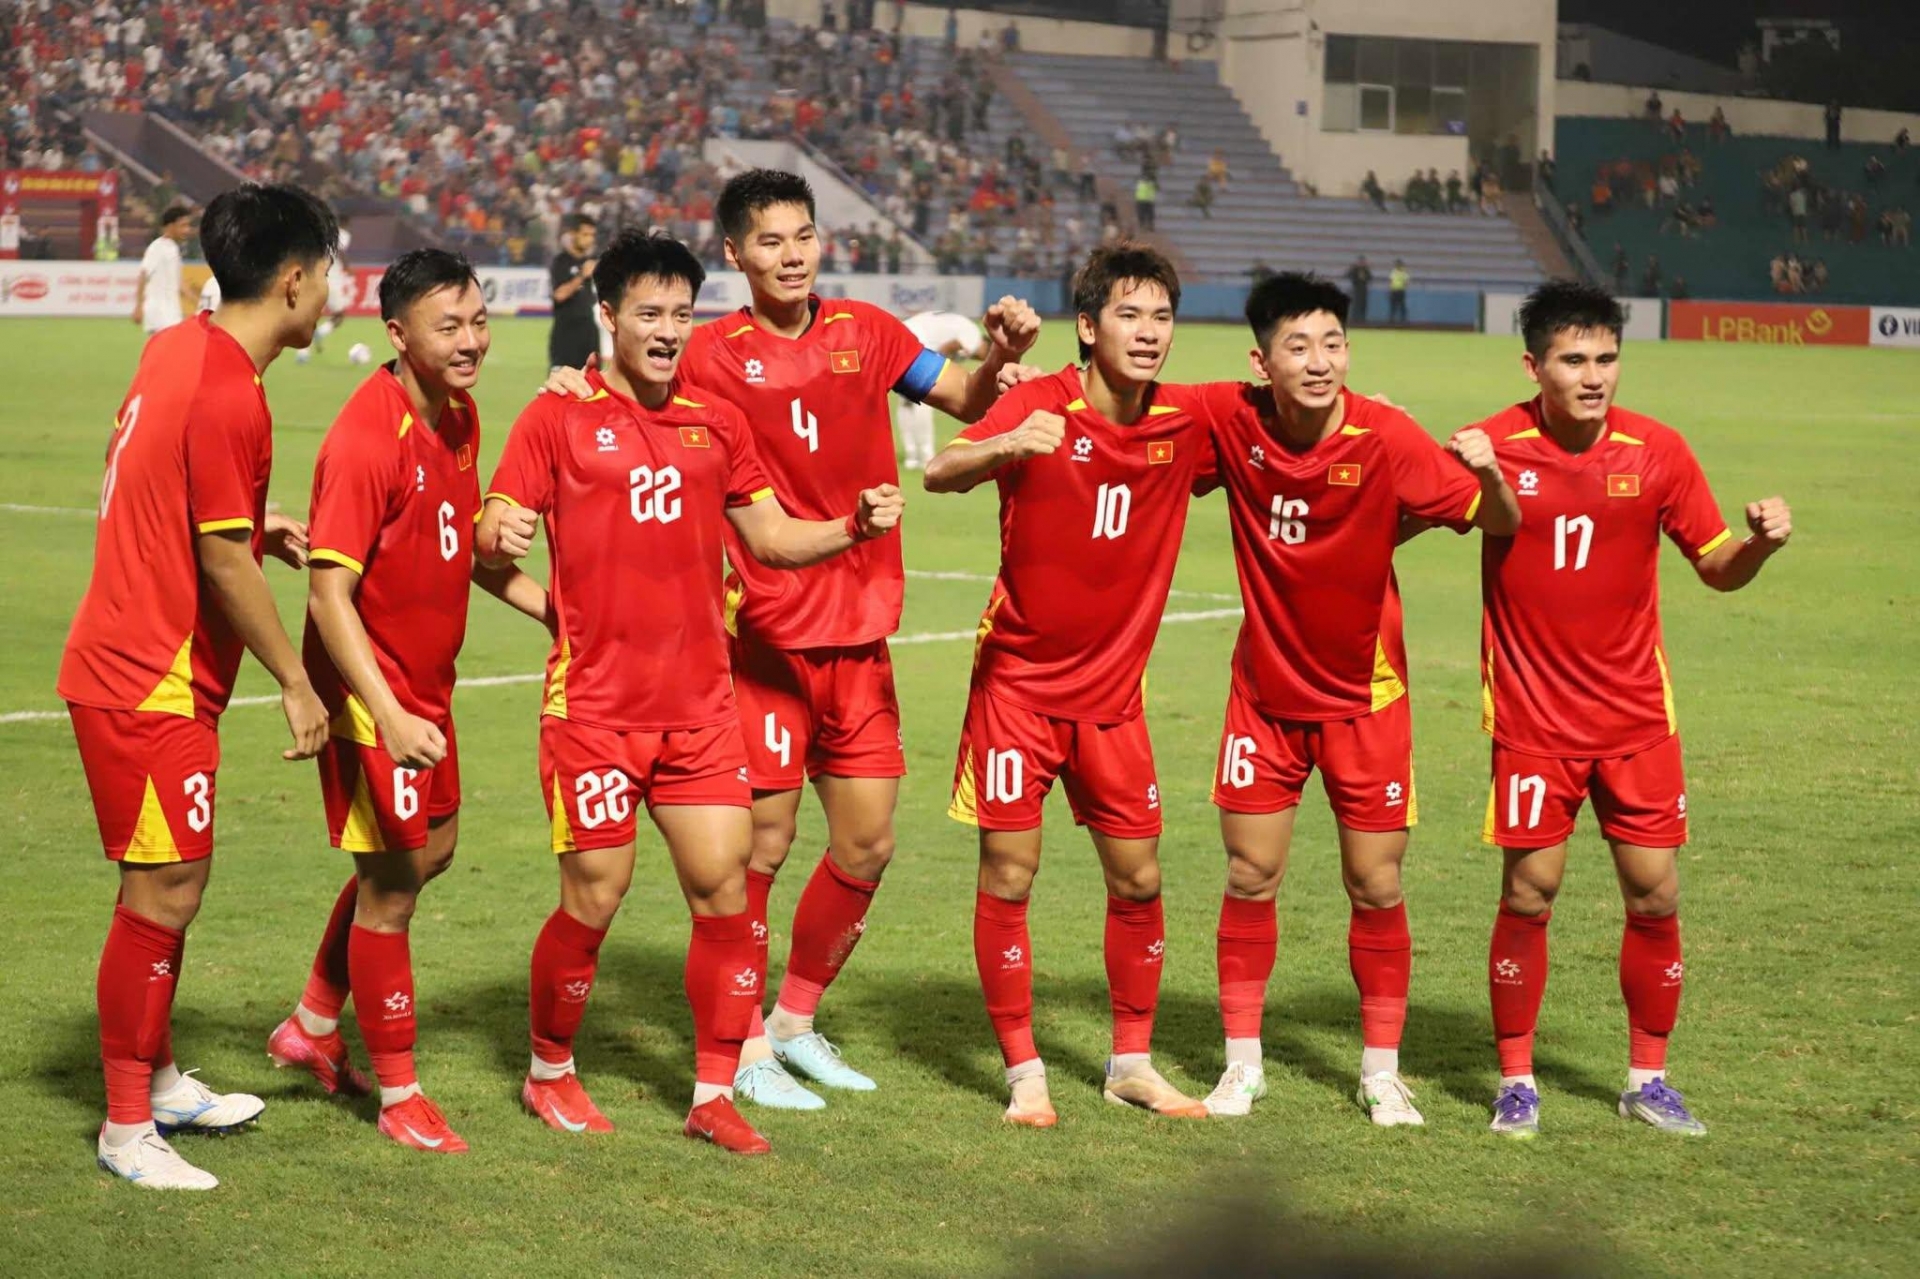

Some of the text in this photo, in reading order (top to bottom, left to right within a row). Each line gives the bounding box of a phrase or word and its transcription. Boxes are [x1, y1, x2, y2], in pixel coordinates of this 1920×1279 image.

[1702, 316, 1805, 346] LPBank
[791, 397, 819, 453] 4
[629, 465, 682, 524] 22
[1092, 483, 1132, 540] 10
[1268, 494, 1309, 545] 16
[438, 500, 459, 561] 6
[1554, 514, 1594, 571] 17
[764, 712, 791, 768] 4
[1222, 733, 1257, 789] 16
[183, 771, 211, 833] 3
[393, 766, 419, 821] 6
[575, 768, 630, 829] 22
[986, 747, 1023, 804] 10
[1508, 773, 1547, 829] 17
